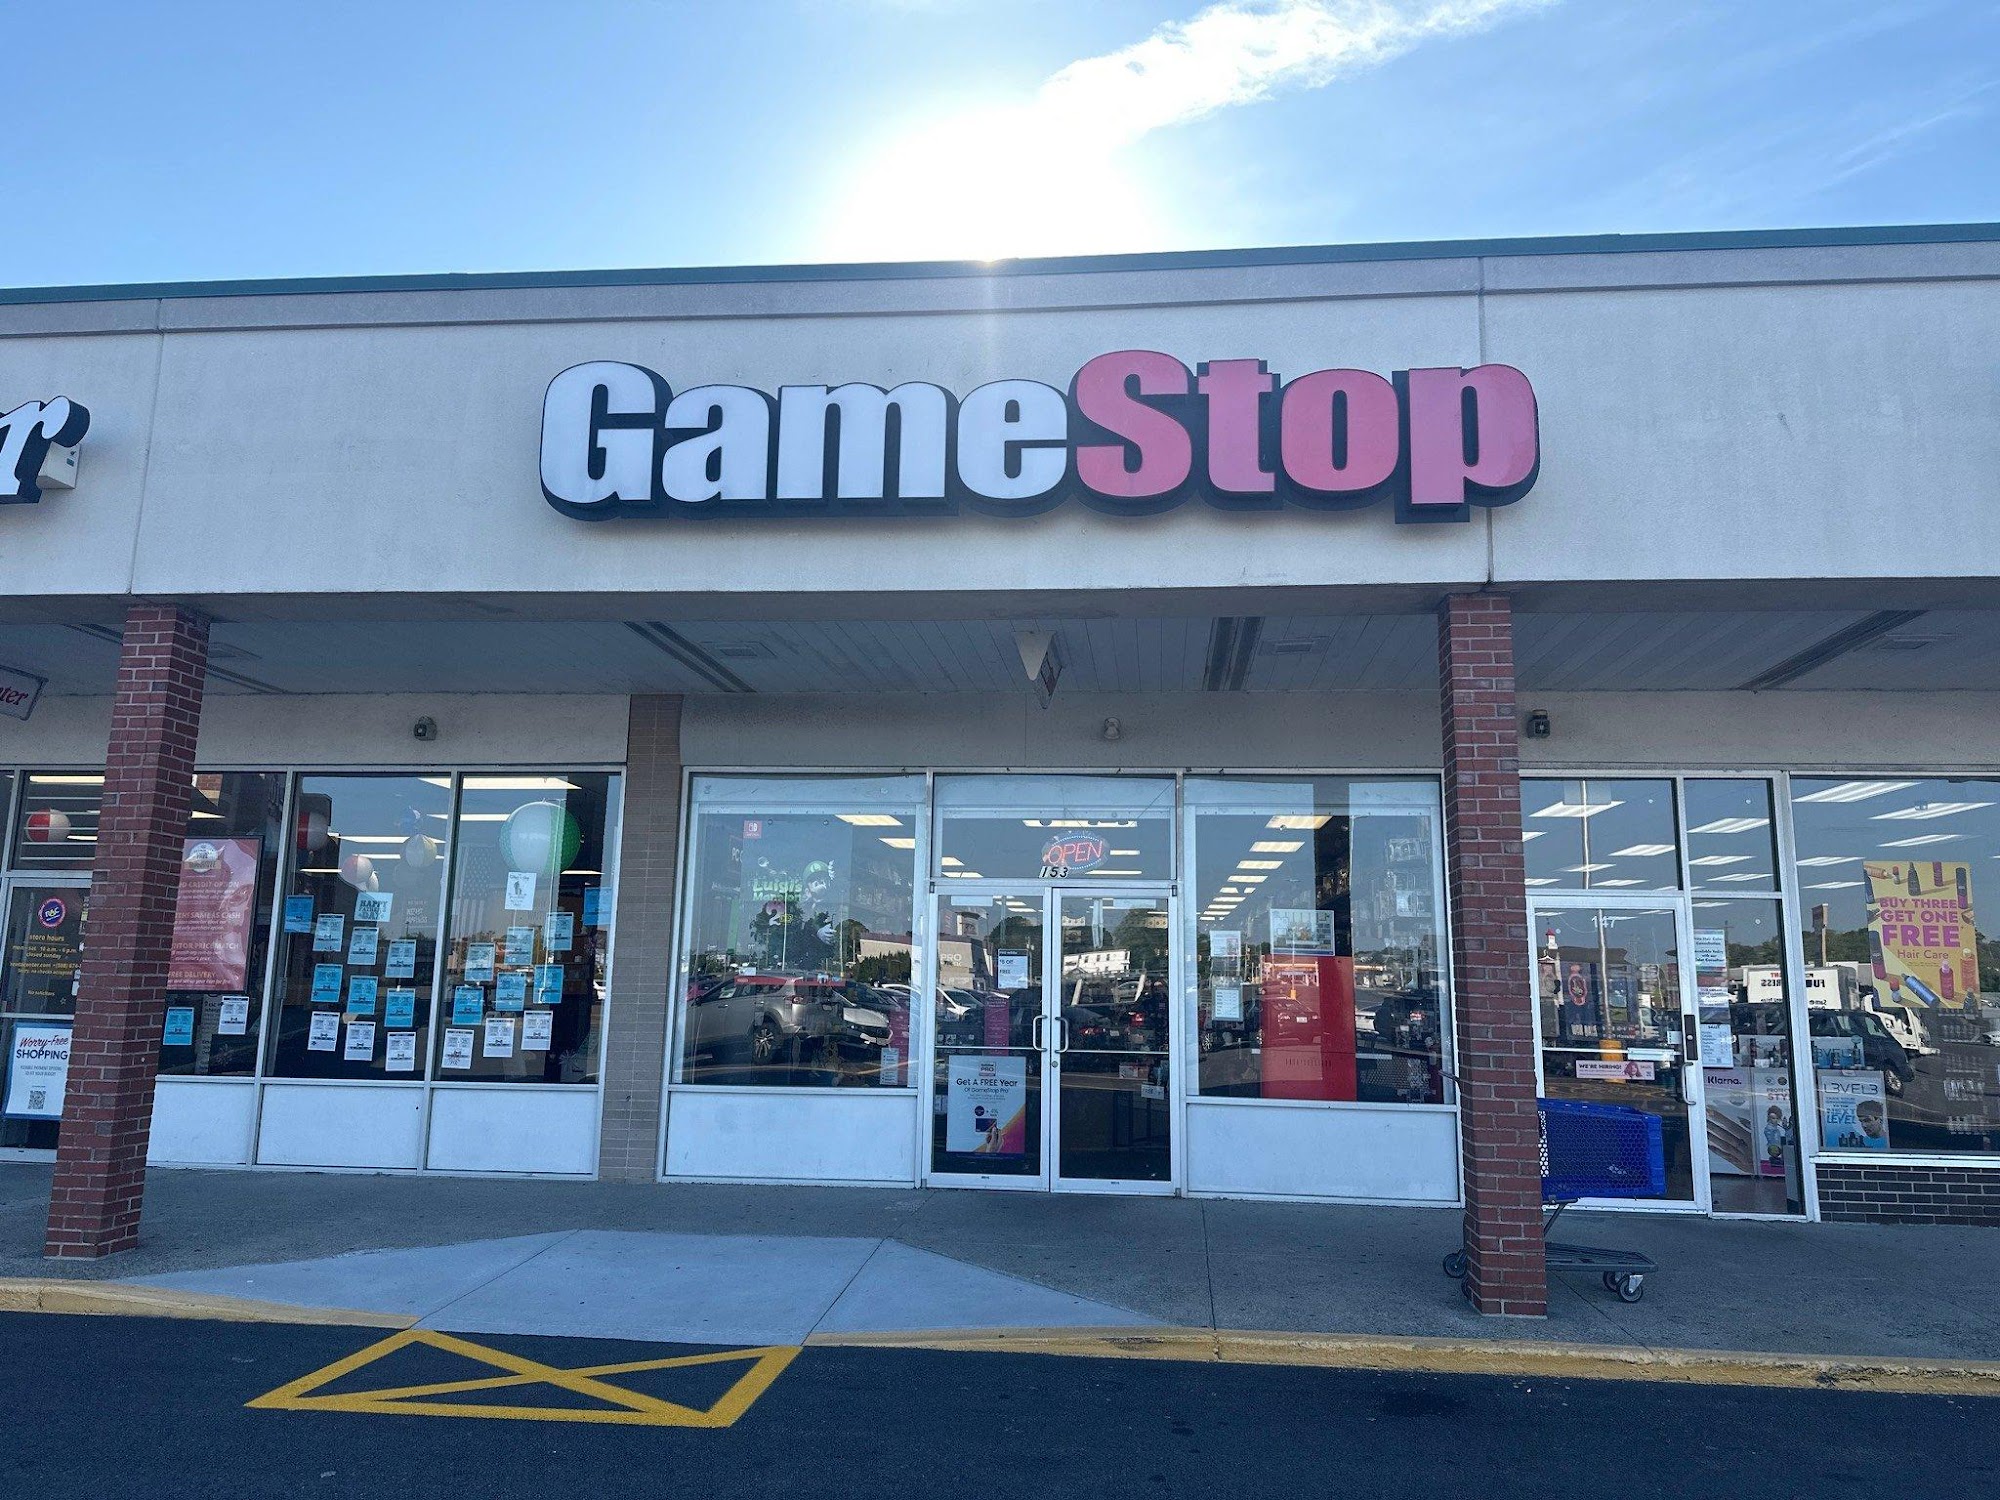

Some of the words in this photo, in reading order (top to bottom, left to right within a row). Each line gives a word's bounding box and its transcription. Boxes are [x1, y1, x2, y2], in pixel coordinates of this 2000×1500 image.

[539, 350, 1539, 521] GameStop
[1048, 840, 1103, 864] OPEN
[1041, 866, 1069, 878] 153
[360, 900, 388, 908] HAPPY
[1880, 897, 1907, 908] BUY
[1912, 898, 1957, 909] THREE
[1591, 915, 1617, 928] 147
[1880, 909, 1915, 922] GET
[1921, 910, 1959, 923] ONE
[1881, 924, 1961, 948] FREE
[1897, 949, 1920, 959] Hair
[1923, 949, 1949, 960] Care
[20, 1035, 69, 1051] Worry-Free
[16, 1049, 69, 1061] SHOPPING
[956, 1078, 970, 1086] Get
[980, 1079, 998, 1087] FREE
[999, 1079, 1018, 1087] Year
[1707, 1076, 1742, 1085] Klarna.
[1826, 1114, 1857, 1125] LEVEL
